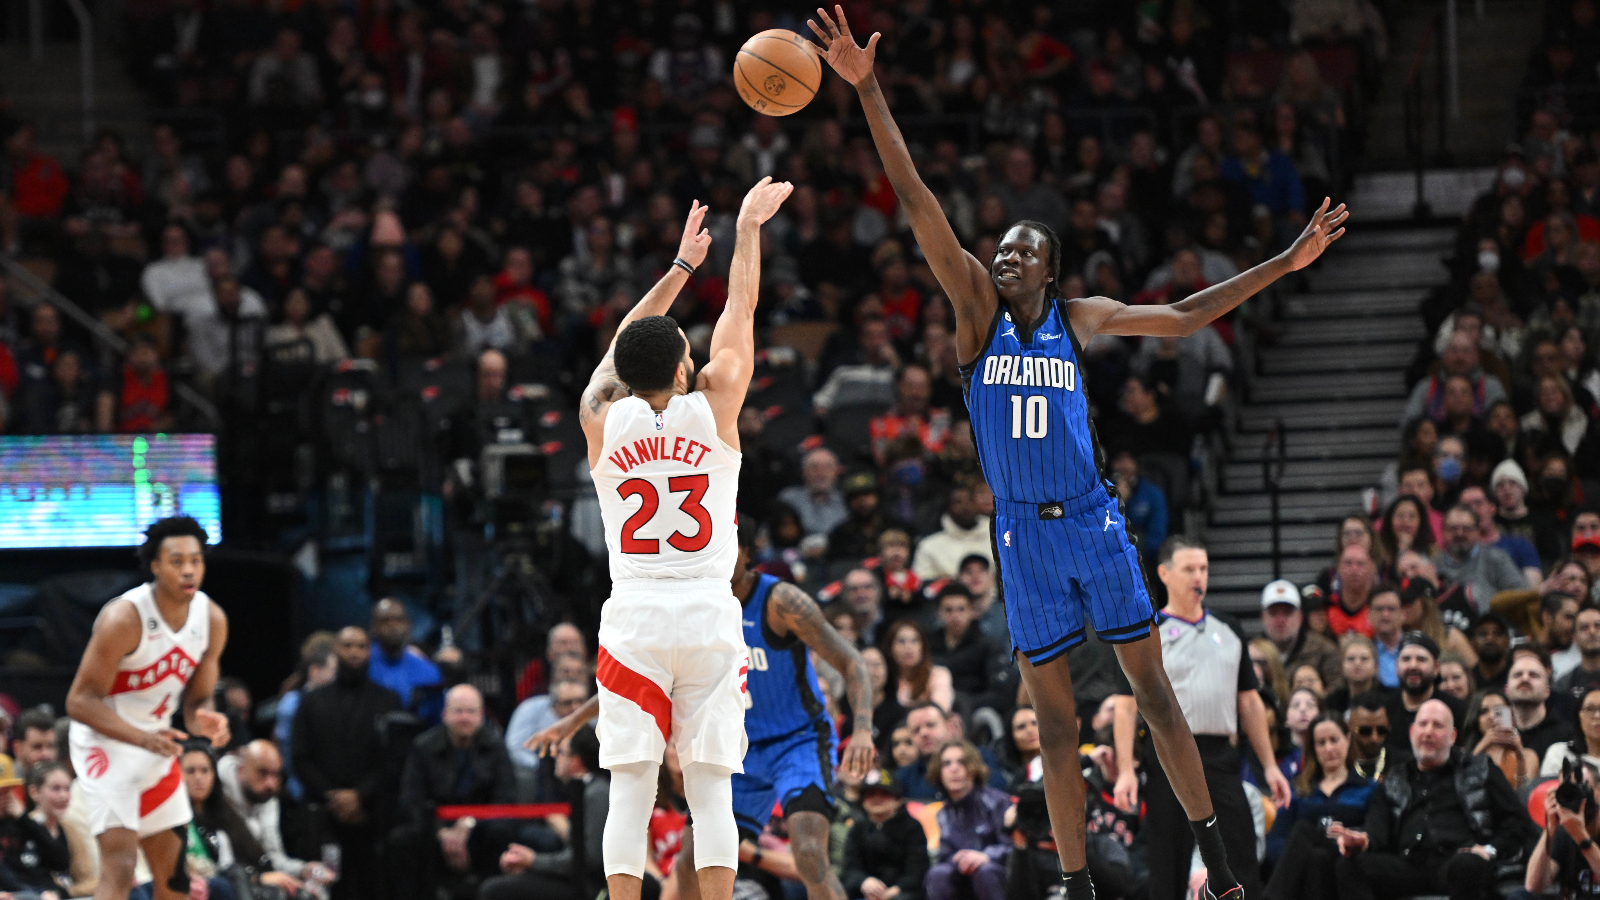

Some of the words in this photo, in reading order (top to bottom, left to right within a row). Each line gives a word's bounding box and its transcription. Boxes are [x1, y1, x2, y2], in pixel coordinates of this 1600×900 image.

[1038, 332, 1062, 341] Disney
[982, 355, 1076, 392] ORLANDO
[1010, 394, 1048, 439] 10
[608, 436, 712, 473] VANVLEET
[616, 473, 713, 554] 23
[150, 692, 172, 719] 4
